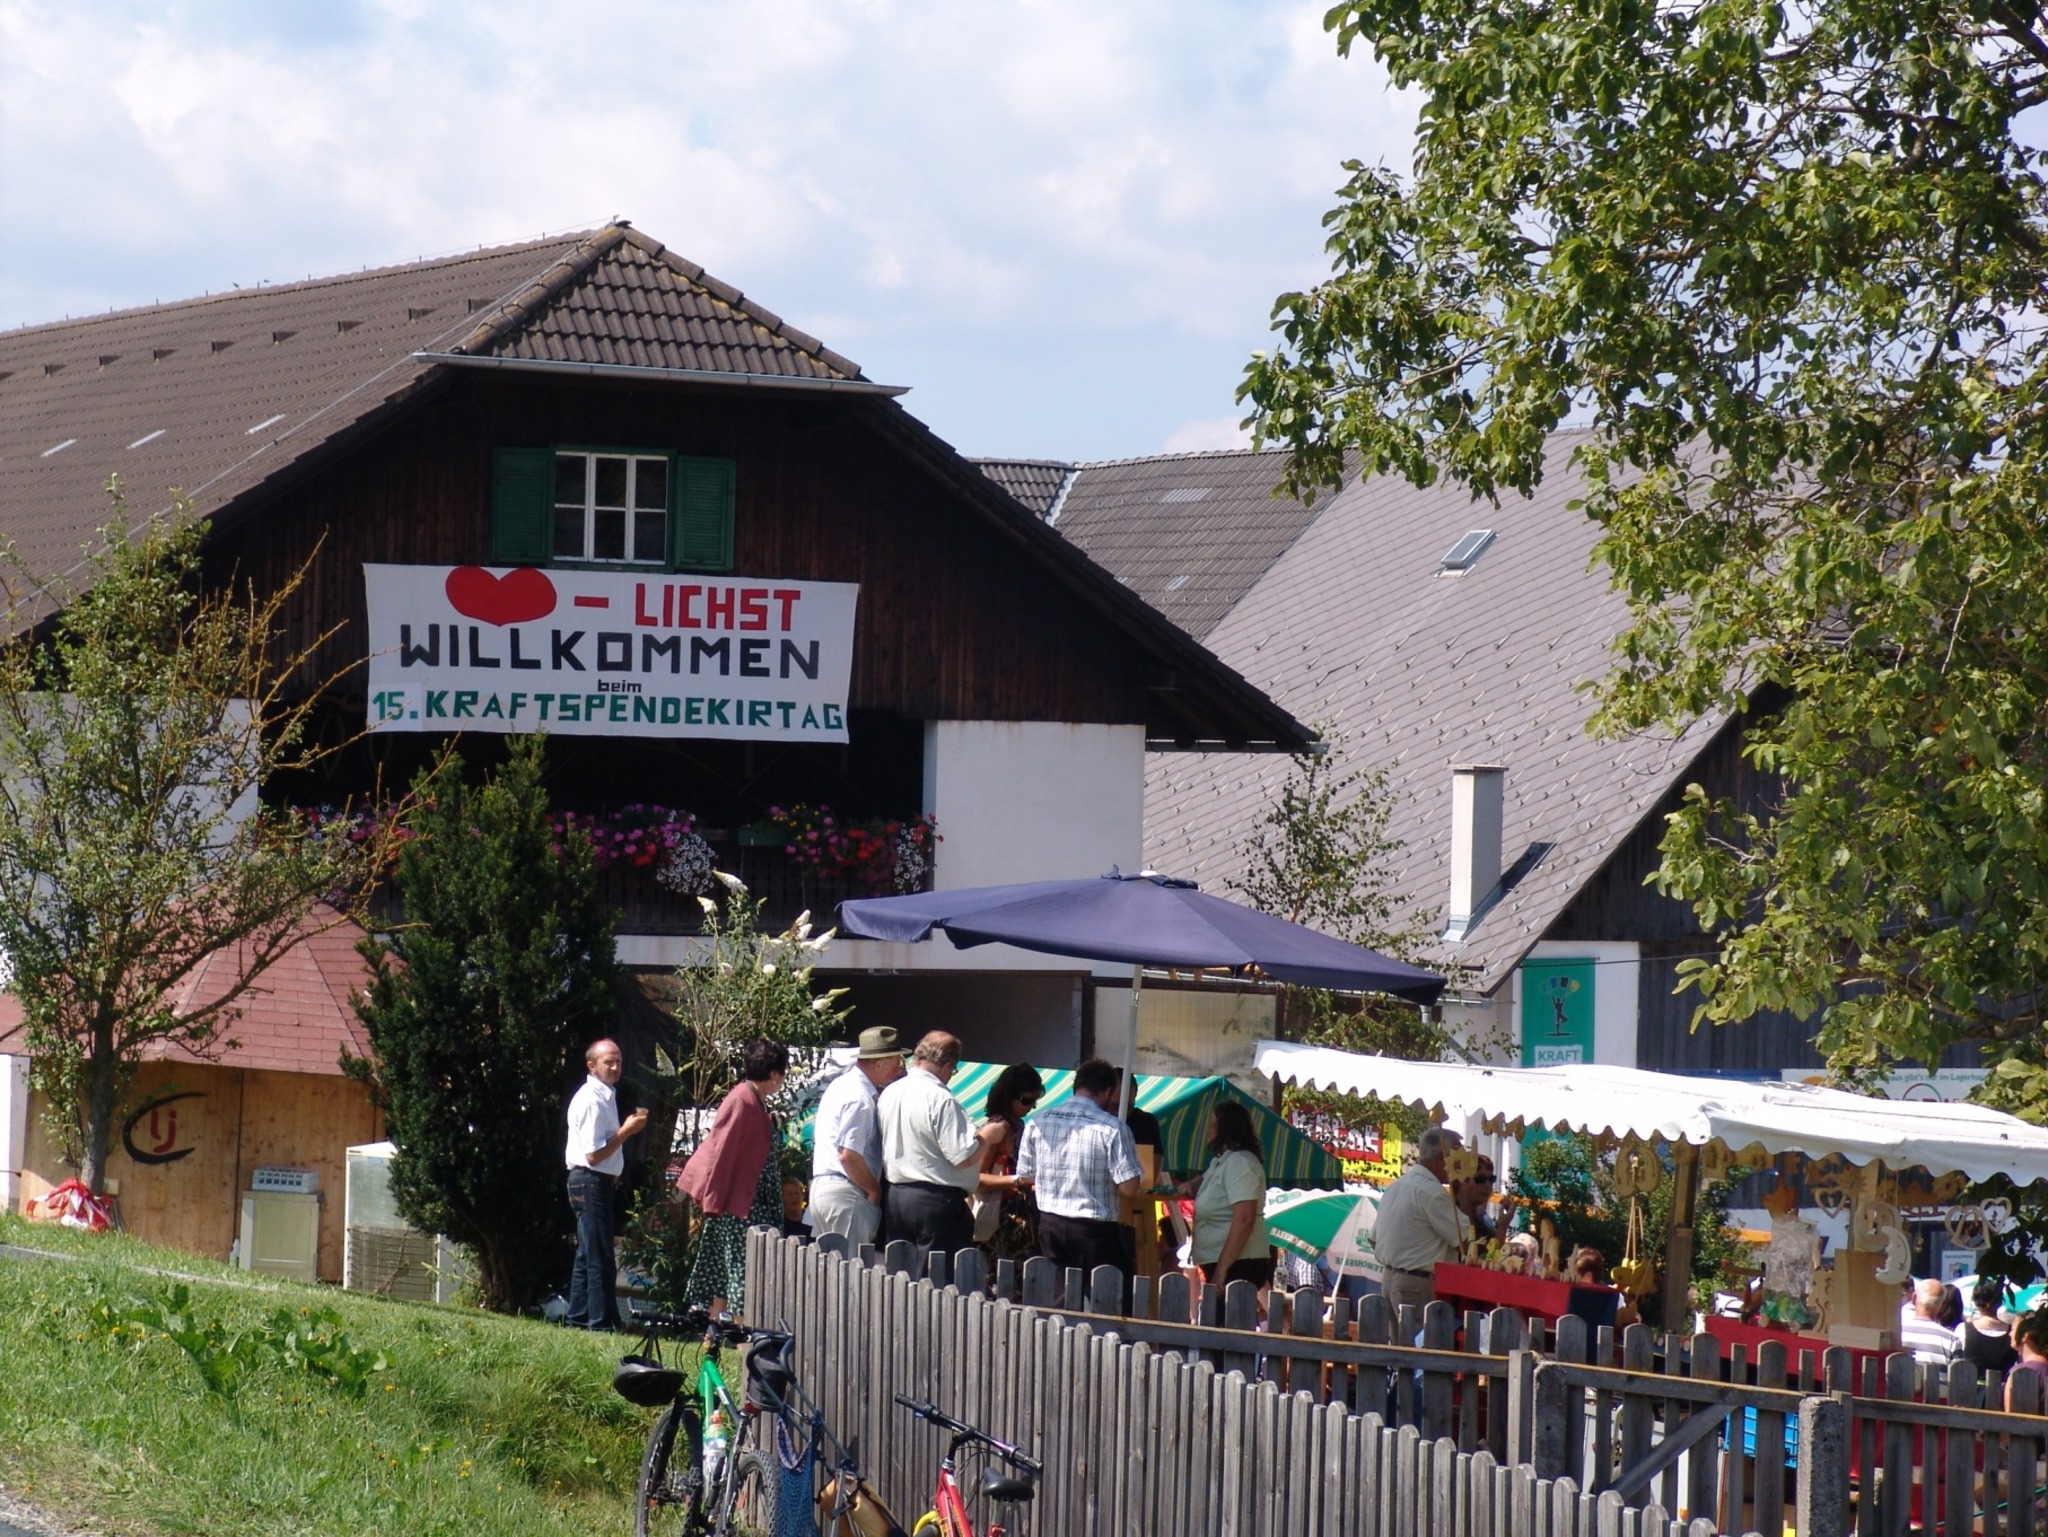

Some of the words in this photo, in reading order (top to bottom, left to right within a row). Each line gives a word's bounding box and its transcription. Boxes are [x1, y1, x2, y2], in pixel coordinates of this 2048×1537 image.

[635, 582, 801, 632] LICHST
[400, 623, 820, 680] WILLKOMMEN
[597, 679, 642, 693] beim
[1537, 1050, 1580, 1062] KRAFT
